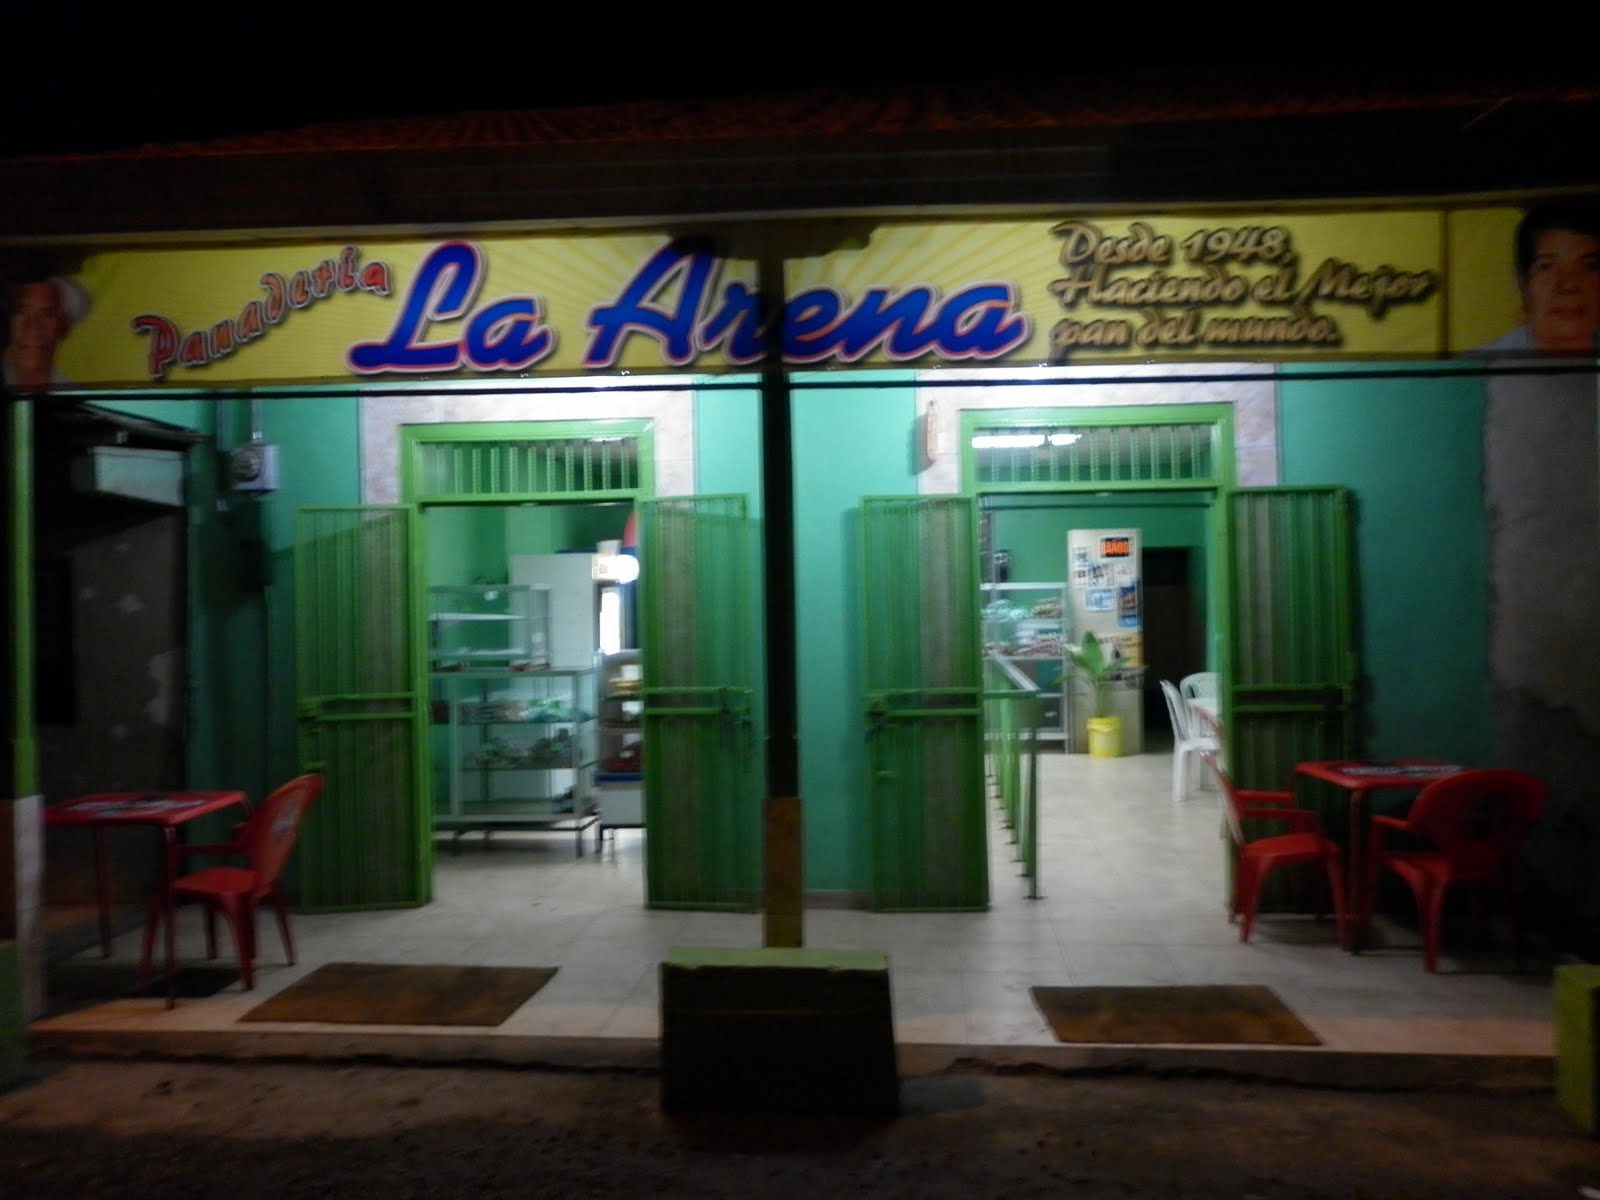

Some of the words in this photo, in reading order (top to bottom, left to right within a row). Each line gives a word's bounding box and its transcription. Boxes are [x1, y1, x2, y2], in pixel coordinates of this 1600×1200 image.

[1050, 220, 1172, 265] Desde
[348, 240, 554, 372] La
[581, 236, 1030, 367] Arena
[1047, 261, 1250, 306] Haciendo
[1252, 264, 1298, 302] el
[1299, 257, 1438, 320] Mejor
[1050, 318, 1131, 366] pan
[1136, 307, 1201, 348] del
